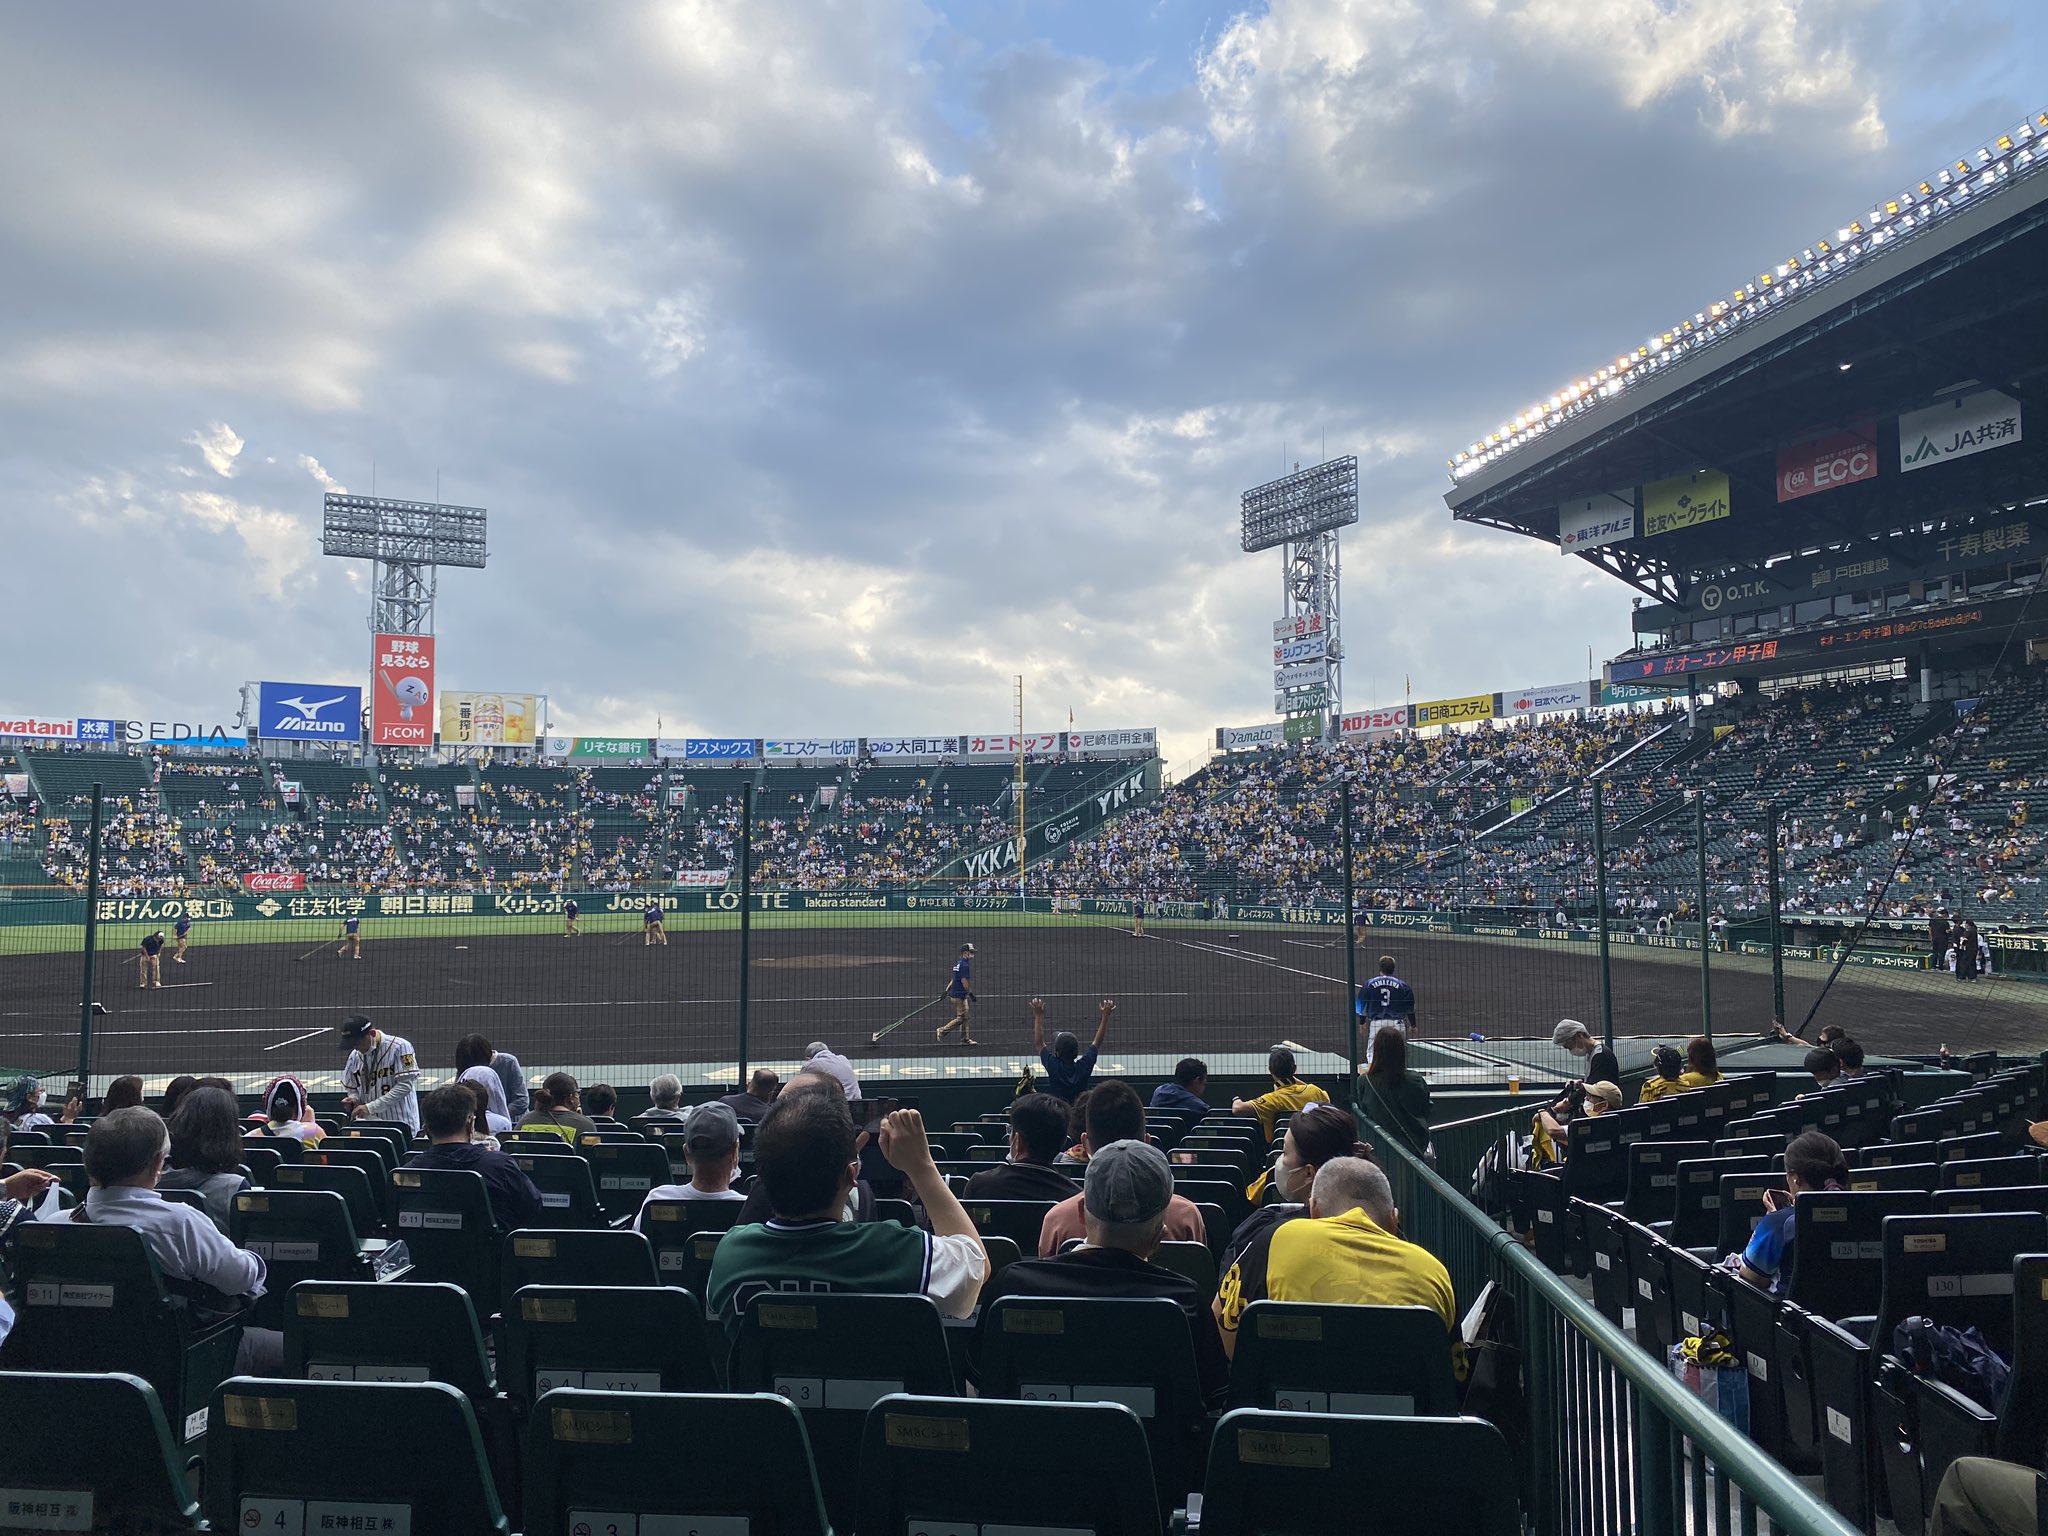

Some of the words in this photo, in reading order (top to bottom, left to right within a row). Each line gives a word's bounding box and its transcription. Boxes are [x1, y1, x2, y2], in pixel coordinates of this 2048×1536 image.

[1944, 417, 2016, 453] JA共済
[1813, 453, 1869, 487] ECC
[1647, 499, 1727, 535] 住友ベークライト
[1577, 517, 1632, 542] 東洋アルミ
[1936, 521, 2031, 562] 千寿製薬
[1834, 556, 1889, 581] 戸田建設
[1726, 580, 1770, 601] O.T.K.
[1274, 625, 1293, 635] さつま
[1295, 612, 1322, 634] 白波
[392, 640, 419, 653] 野球
[1284, 640, 1324, 659] シノブフーズ
[380, 654, 430, 668] 見るなら
[1663, 641, 1778, 674] #オーエン甲子園
[1534, 694, 1581, 707] 日本ペイント
[1429, 700, 1490, 719] 日商エステム
[82, 721, 109, 734] 水素
[274, 716, 346, 732] MIZUNO
[459, 702, 472, 741] 一番搾り
[1298, 721, 1315, 734] 生茶
[1341, 709, 1406, 732] オロナミンC
[127, 720, 228, 744] SEDIA
[381, 727, 425, 739] J:COM
[1083, 730, 1154, 747] 尼崎信用金庫
[1230, 729, 1273, 745] Yamato
[585, 740, 642, 754] りそな銀行
[687, 741, 751, 755] シスメックス
[783, 740, 857, 756] エスケー化研
[896, 738, 959, 754] 大同工業
[971, 735, 1056, 754] カニトップ
[1097, 771, 1144, 816] YKK
[964, 844, 1003, 881] YKK
[251, 875, 298, 890] Coca-Cola
[97, 899, 226, 920] ほけんの窓口
[287, 897, 366, 916] 住友化学
[380, 896, 473, 914] 朝日新聞
[607, 893, 678, 910] Joshin
[803, 897, 838, 908] Takara
[839, 896, 886, 908] standard
[919, 897, 956, 907] 竹中工務店
[1289, 909, 1321, 924] 東海大学
[1988, 937, 2039, 951] 三井住友海上
[1871, 956, 1919, 969] アサヒスーパードライ
[1380, 988, 1391, 1007] 3
[410, 1216, 418, 1224] 11
[1837, 1246, 1852, 1256] 128
[676, 1256, 683, 1266] 5
[1935, 1281, 1954, 1292] 130
[43, 1290, 53, 1300] 11
[1753, 1356, 1759, 1367] D
[801, 1386, 810, 1400] 3
[233, 1406, 286, 1420] SMBCシート
[1304, 1399, 1311, 1413] 1
[562, 1420, 618, 1432] SMBCシート
[896, 1425, 961, 1440] SMBCシート
[1250, 1441, 1318, 1456] SMBCシート
[274, 1510, 287, 1529] 4
